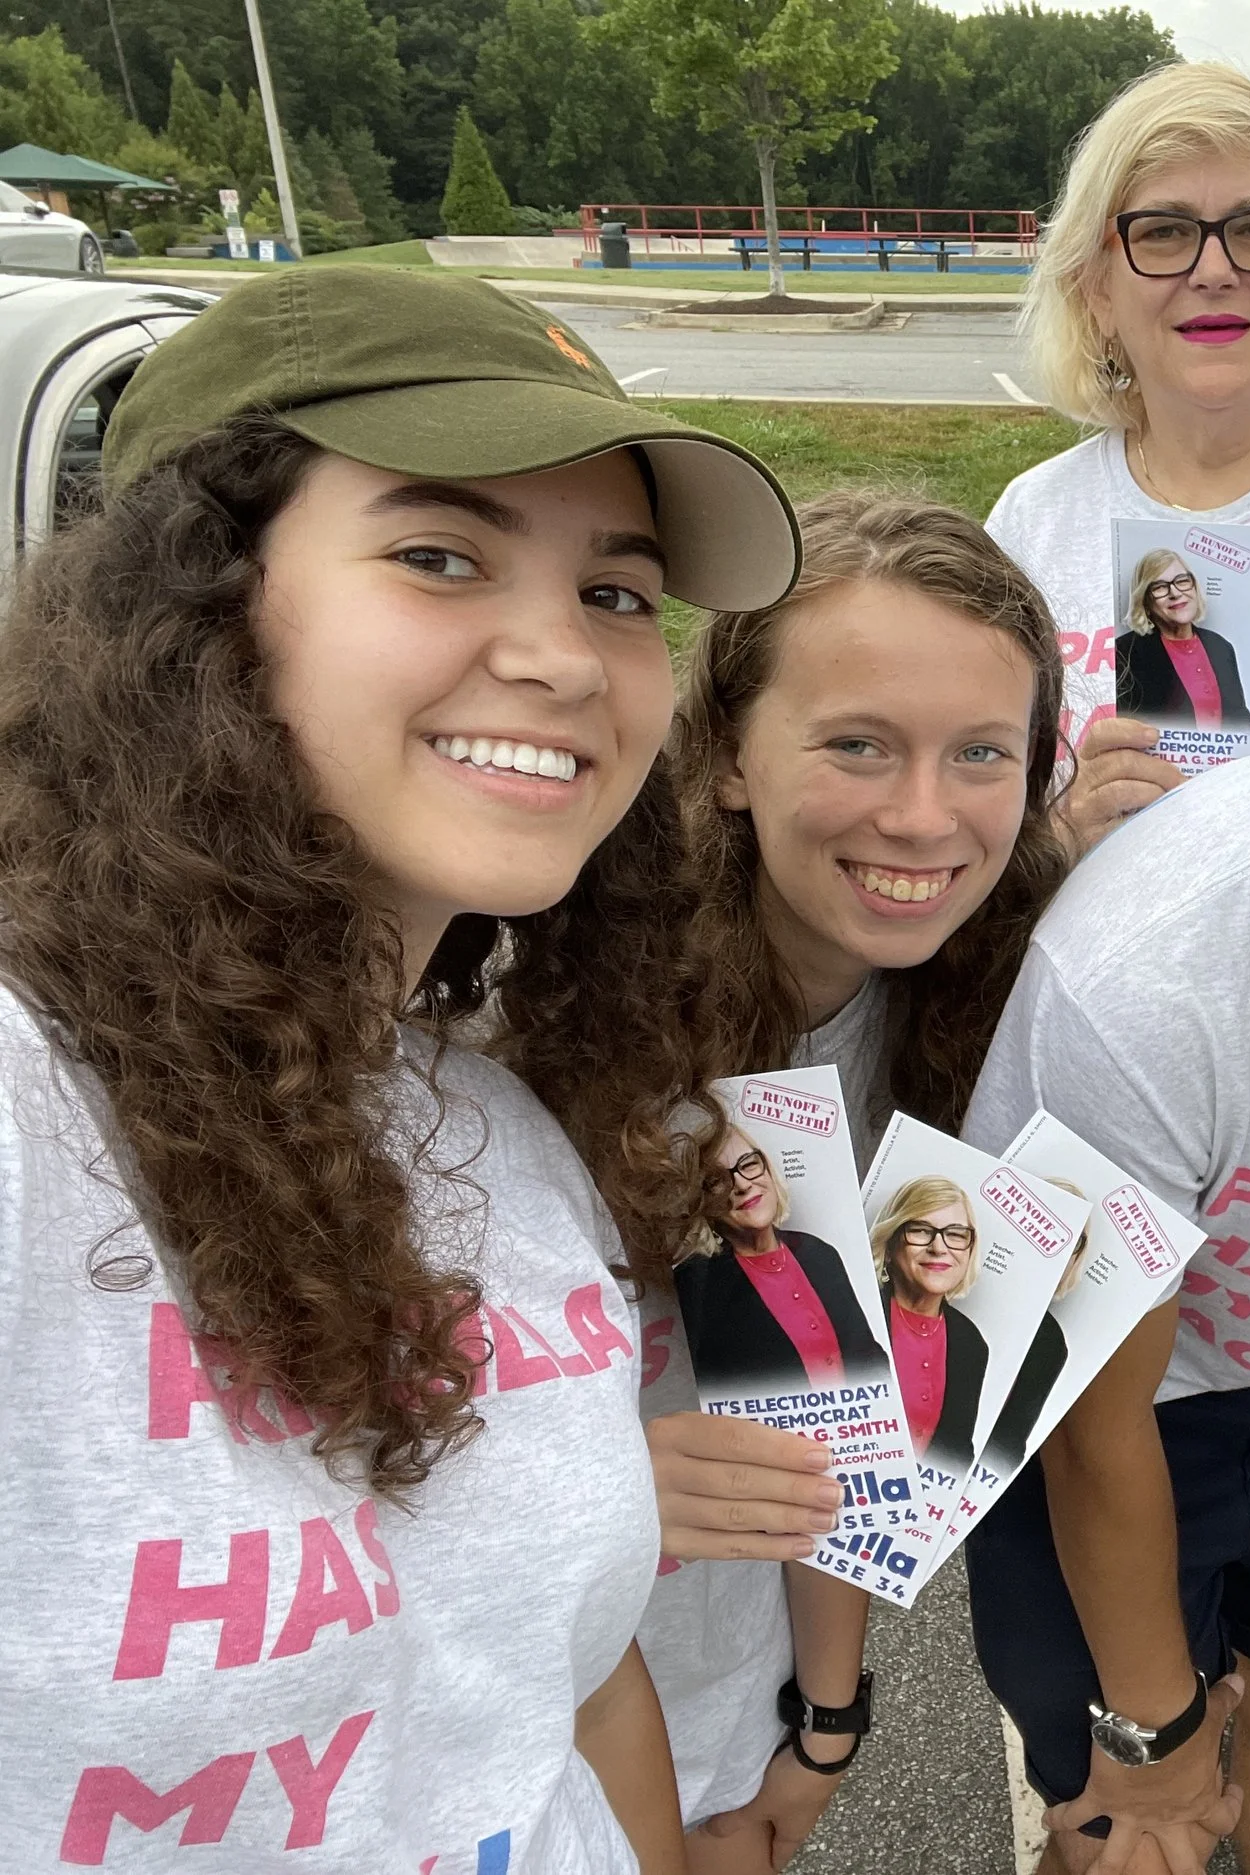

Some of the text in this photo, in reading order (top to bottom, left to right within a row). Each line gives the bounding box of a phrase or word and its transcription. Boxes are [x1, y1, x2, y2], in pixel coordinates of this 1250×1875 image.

[1189, 542, 1247, 570] JULY 13TH!
[1201, 535, 1241, 557] RUNOFF
[1160, 742, 1234, 755] DEMOCRAT
[1214, 733, 1248, 744] DAY!
[1191, 755, 1204, 764] G.
[763, 1091, 820, 1114] RUNOFF
[748, 1103, 830, 1131] JULY 13TH!
[987, 1187, 1058, 1252] JULY 13TH!
[1007, 1184, 1056, 1232] RUNOFF
[1109, 1201, 1163, 1272] JULY 13TH!
[1127, 1202, 1165, 1254] RUNOFF
[708, 1384, 889, 1415] IT'S ELECTION DAY!
[766, 1405, 872, 1430] DEMOCRAT
[814, 1428, 834, 1442] G.
[838, 1418, 899, 1440] SMITH
[832, 1442, 879, 1456] LACE AT:
[887, 1508, 919, 1526] 34
[112, 1500, 400, 1681] HAS
[876, 1577, 905, 1599] 34
[59, 1710, 376, 1866] MY
